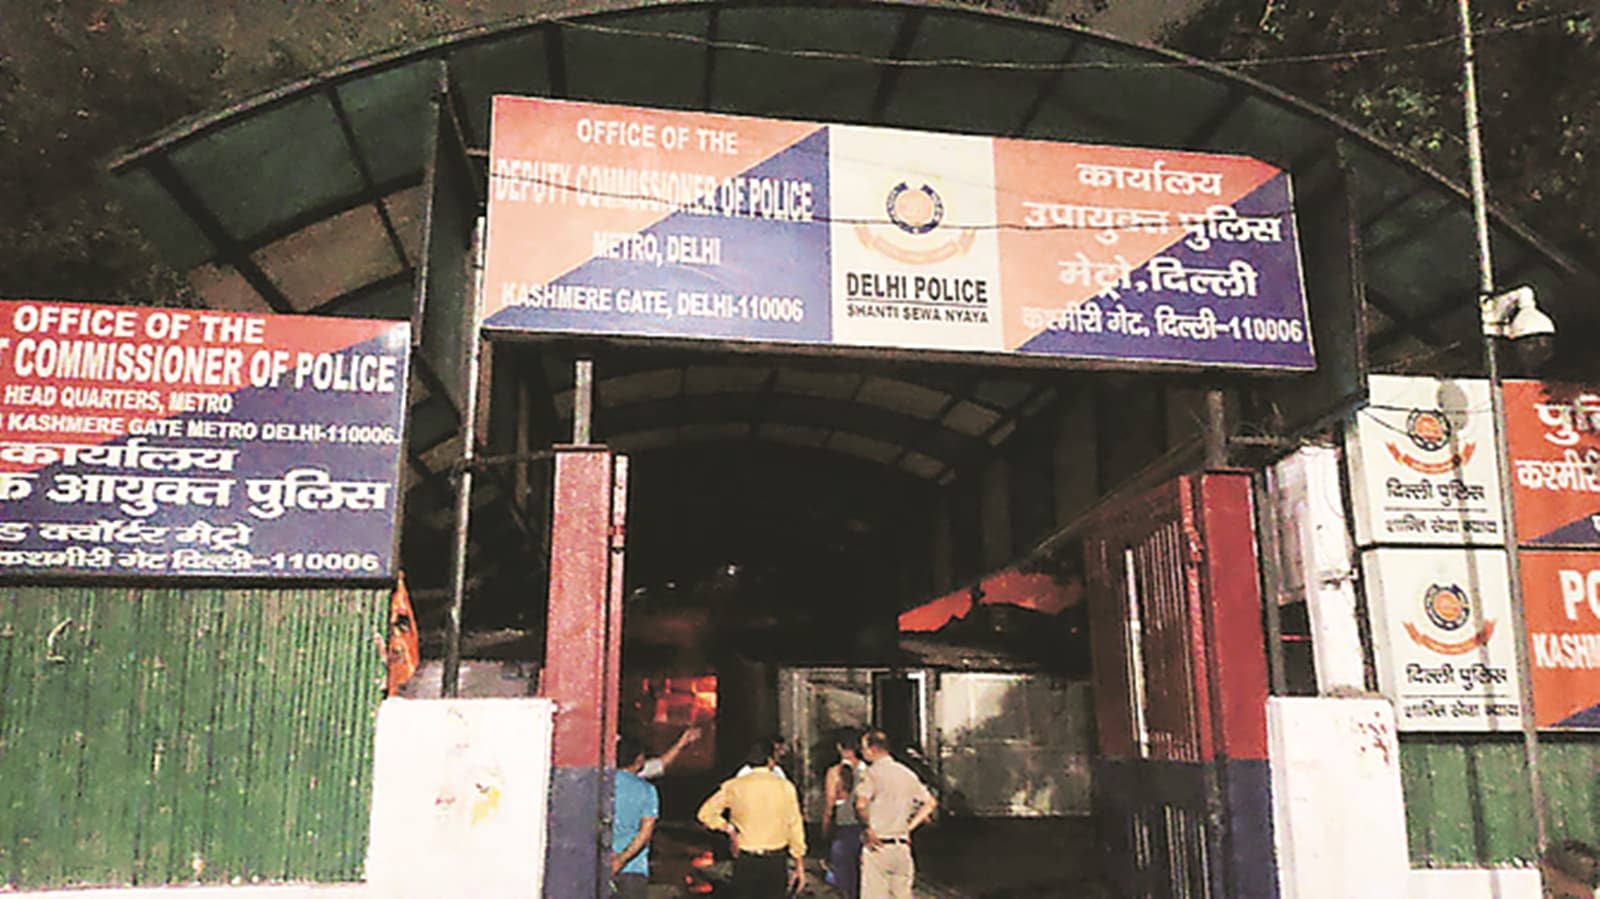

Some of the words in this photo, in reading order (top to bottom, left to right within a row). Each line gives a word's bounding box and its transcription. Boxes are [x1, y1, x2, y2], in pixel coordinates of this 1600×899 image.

[576, 118, 655, 148] OFFICE
[661, 125, 690, 149] OF
[696, 129, 738, 155] THE
[496, 158, 571, 203] DEPUTY
[575, 164, 718, 216] COMMISSIONER
[721, 178, 746, 217] OF
[749, 178, 814, 222] POLICE
[1076, 161, 1223, 196] कार्यालय
[1021, 201, 1170, 245] उपायुक्त
[1177, 204, 1283, 251] पुलिस
[593, 231, 663, 267] METRO,
[667, 235, 721, 265] DELHI
[501, 282, 612, 312] KASHMERE
[616, 288, 673, 320] GATE,
[677, 293, 804, 322] DELHI-110006
[846, 272, 907, 299] DELHI
[914, 276, 988, 303] POLICE
[13, 305, 138, 337] OFFICE
[144, 312, 191, 340] OF
[200, 316, 266, 344] THE
[847, 304, 899, 318] SHANTI
[902, 307, 942, 321] SEWA
[945, 309, 989, 323] NYAYA
[14, 338, 244, 387] COMMISSIONER
[249, 350, 290, 388] OF
[294, 351, 397, 393] POLICE
[4, 384, 57, 406] HEAD
[61, 386, 165, 414] QUARTERS,
[168, 391, 233, 414] METRO
[8, 412, 125, 435] KASHMERE
[128, 418, 182, 437] GATE
[187, 418, 258, 439] METRO
[0, 438, 239, 471] कार्यालय
[46, 474, 236, 517] आयुक्त
[246, 468, 391, 519] पुलिस
[1386, 477, 1434, 500] दिल्ली
[1437, 478, 1486, 506] पुलिस
[1406, 663, 1455, 684] दिल्ली
[1458, 663, 1508, 691] पुलिस
